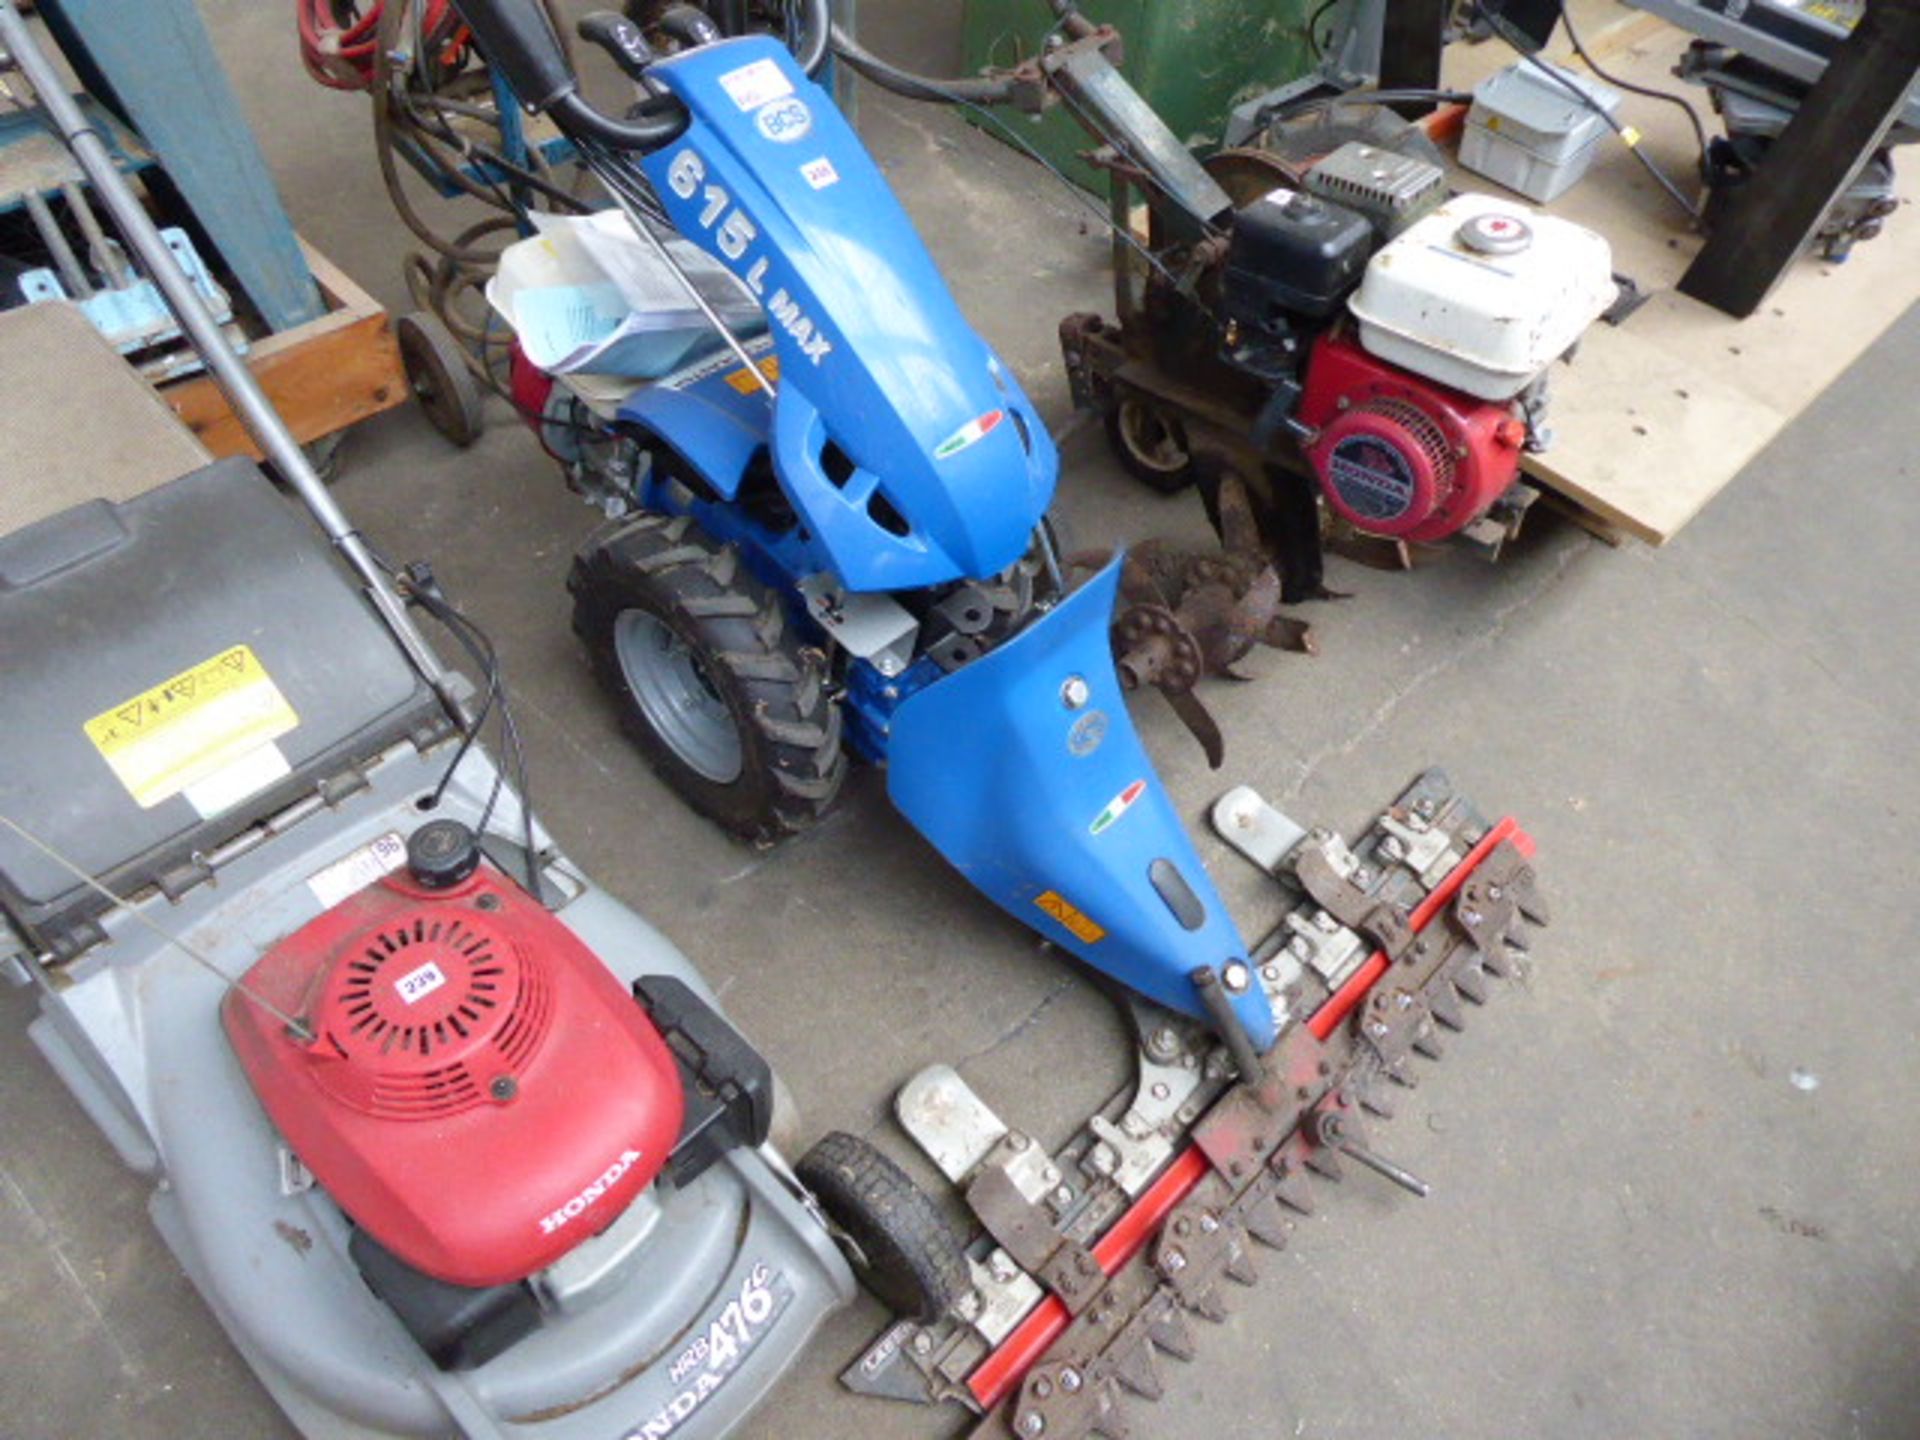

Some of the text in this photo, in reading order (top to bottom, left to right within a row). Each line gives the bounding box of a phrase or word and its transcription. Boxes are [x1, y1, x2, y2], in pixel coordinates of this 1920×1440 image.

[762, 103, 806, 136] BCS
[667, 149, 757, 260] 615
[746, 255, 770, 296] L
[767, 287, 833, 368] MAX
[539, 1150, 642, 1234] HONDA
[626, 1372, 724, 1440] NDA
